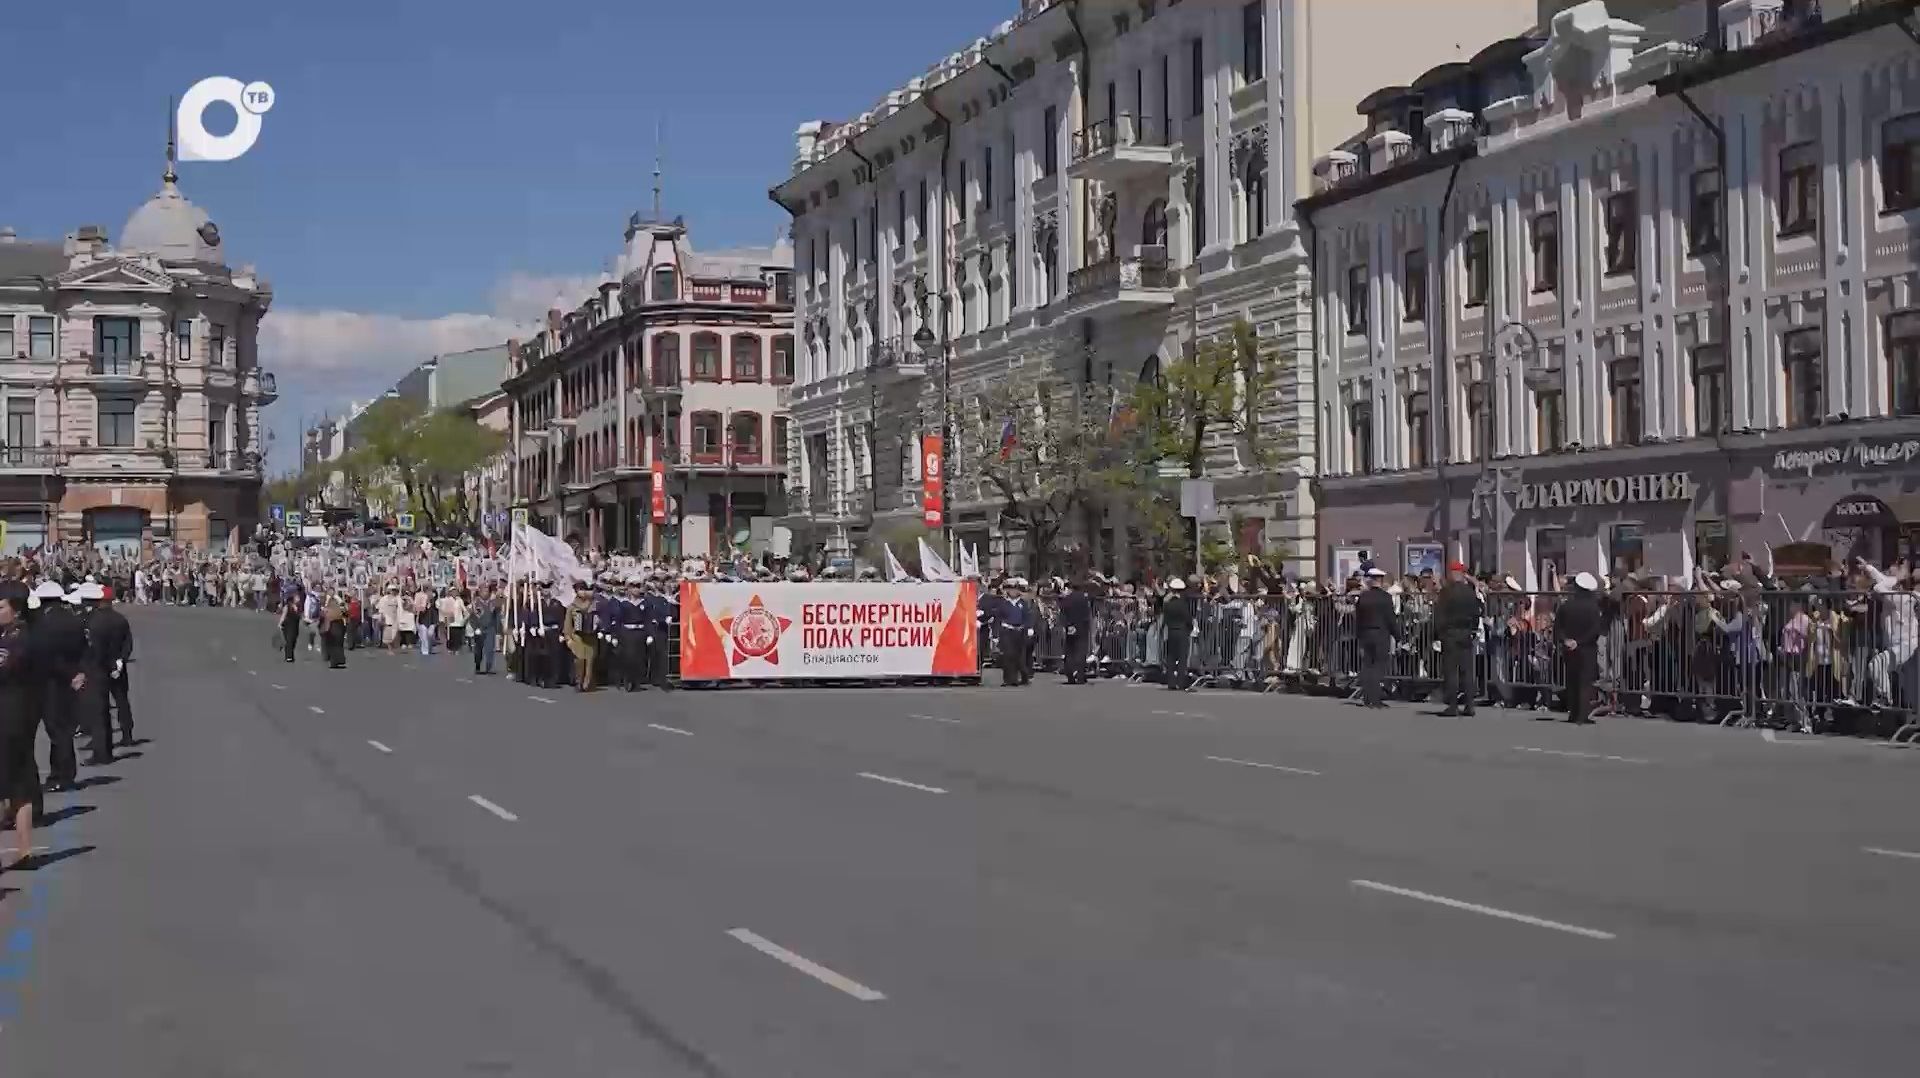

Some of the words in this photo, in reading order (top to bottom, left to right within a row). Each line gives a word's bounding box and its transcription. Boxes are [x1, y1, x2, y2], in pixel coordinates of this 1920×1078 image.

[802, 598, 943, 625] БЕССМЕРТНЫЙ
[803, 627, 854, 649] ПОЛК
[860, 626, 934, 648] РОССИИ
[803, 652, 880, 666] Владивосток
